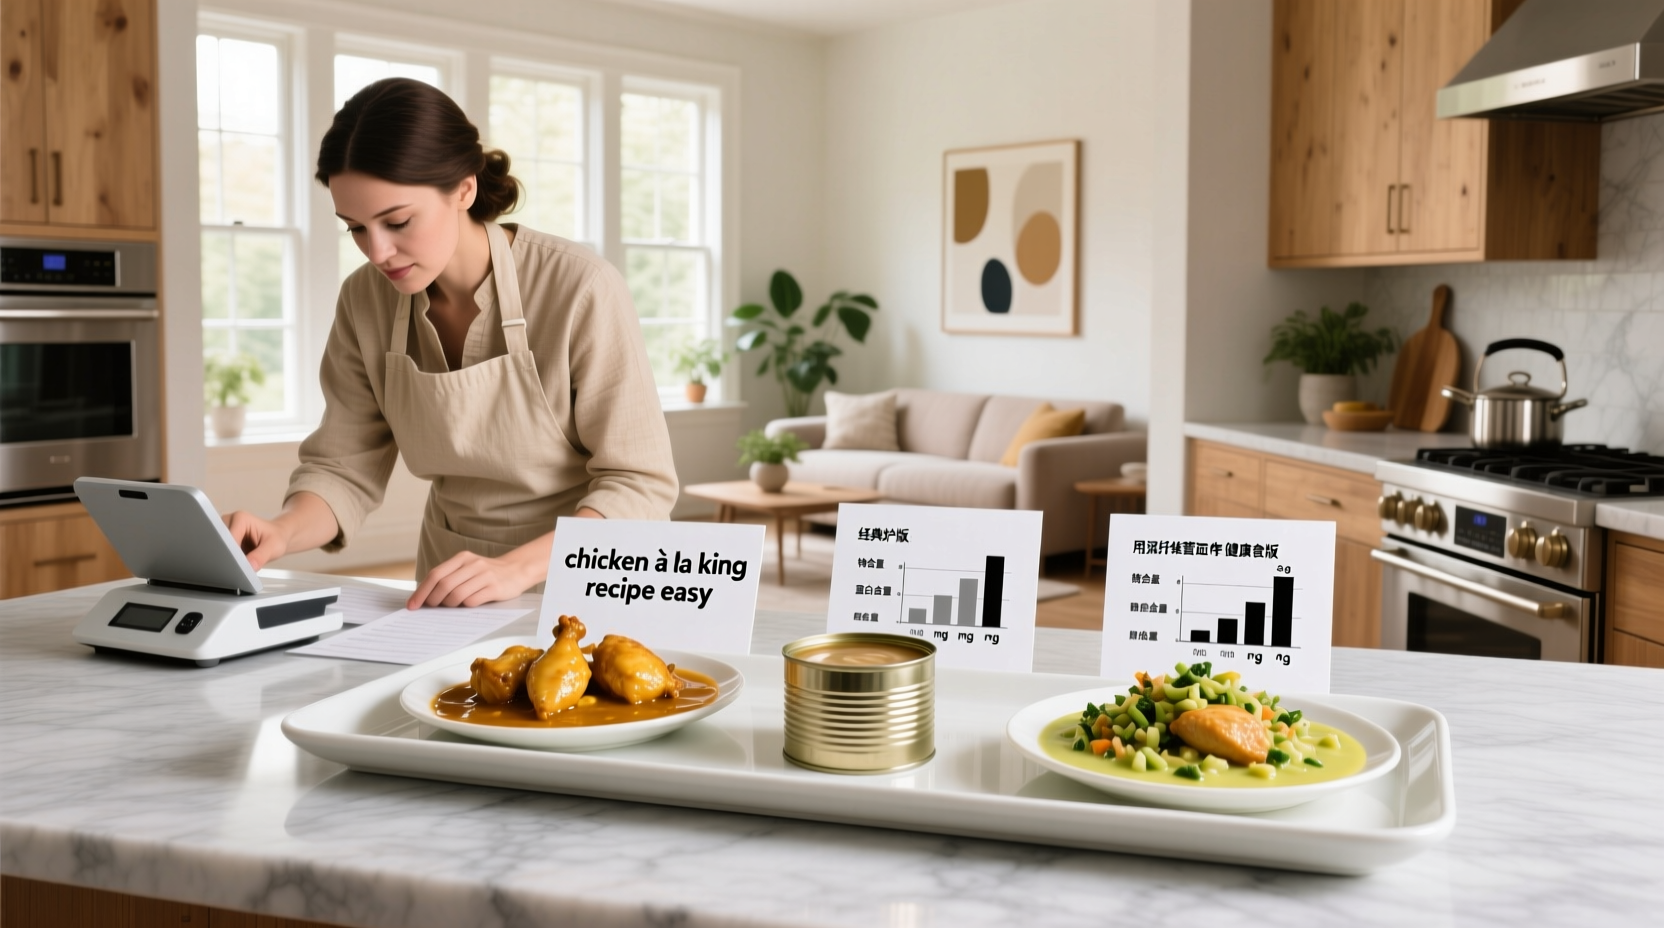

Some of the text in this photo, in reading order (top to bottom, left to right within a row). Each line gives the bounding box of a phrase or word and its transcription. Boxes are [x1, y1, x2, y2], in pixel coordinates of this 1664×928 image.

[564, 547, 748, 582] chicken à la king
[585, 577, 713, 609] recipe easy
[933, 630, 949, 641] mg
[958, 632, 974, 643] mg
